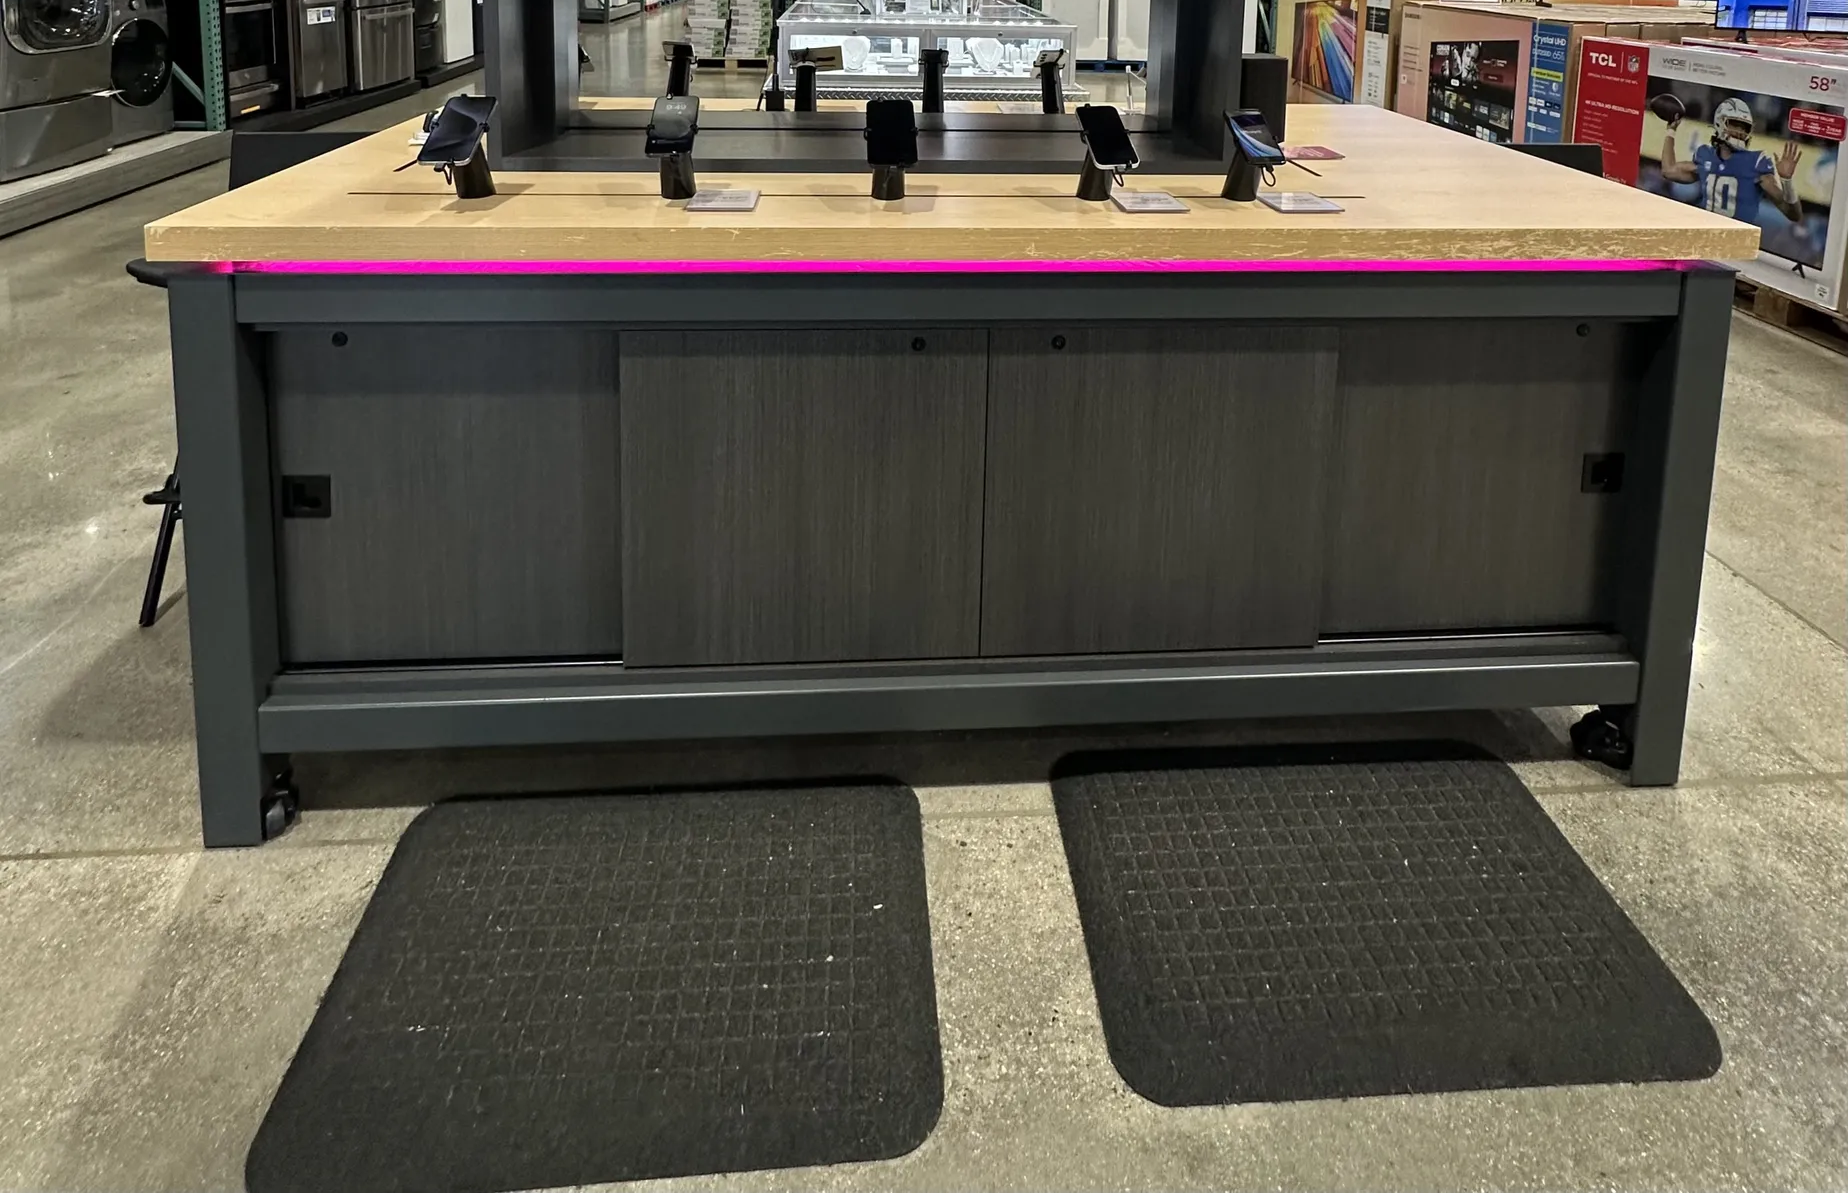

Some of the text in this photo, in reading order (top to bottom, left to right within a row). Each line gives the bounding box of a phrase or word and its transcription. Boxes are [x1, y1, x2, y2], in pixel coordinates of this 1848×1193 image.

[1533, 34, 1567, 46] Crystal UHD
[1589, 52, 1617, 68] TCL
[1809, 76, 1837, 91] 58"
[1705, 173, 1739, 218] 10
